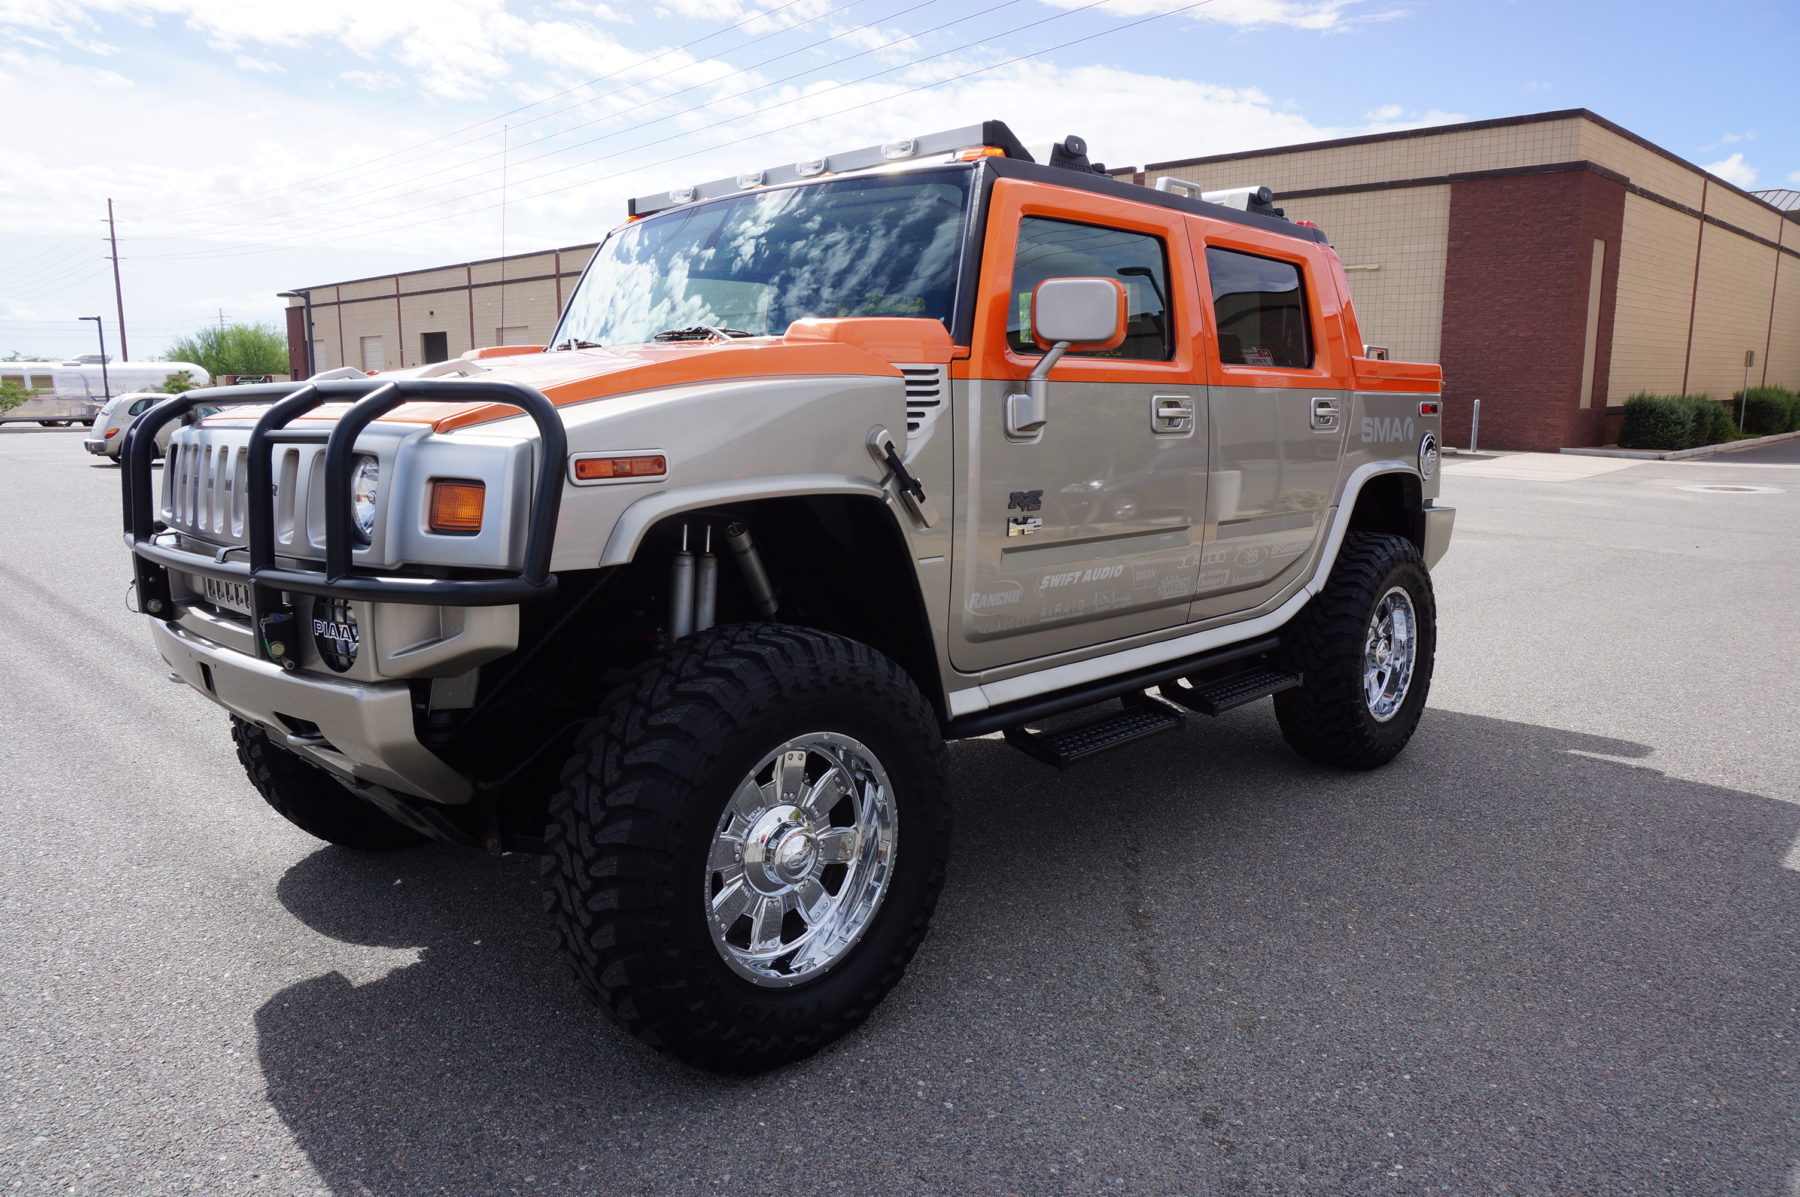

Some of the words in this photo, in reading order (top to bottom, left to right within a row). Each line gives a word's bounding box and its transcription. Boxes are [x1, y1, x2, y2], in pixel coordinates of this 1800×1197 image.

[1006, 515, 1043, 537] H2
[1039, 570, 1082, 590] SWIFT
[1081, 564, 1124, 583] AUDIO
[967, 589, 1021, 609] RANCHO
[313, 618, 353, 643] PIAA
